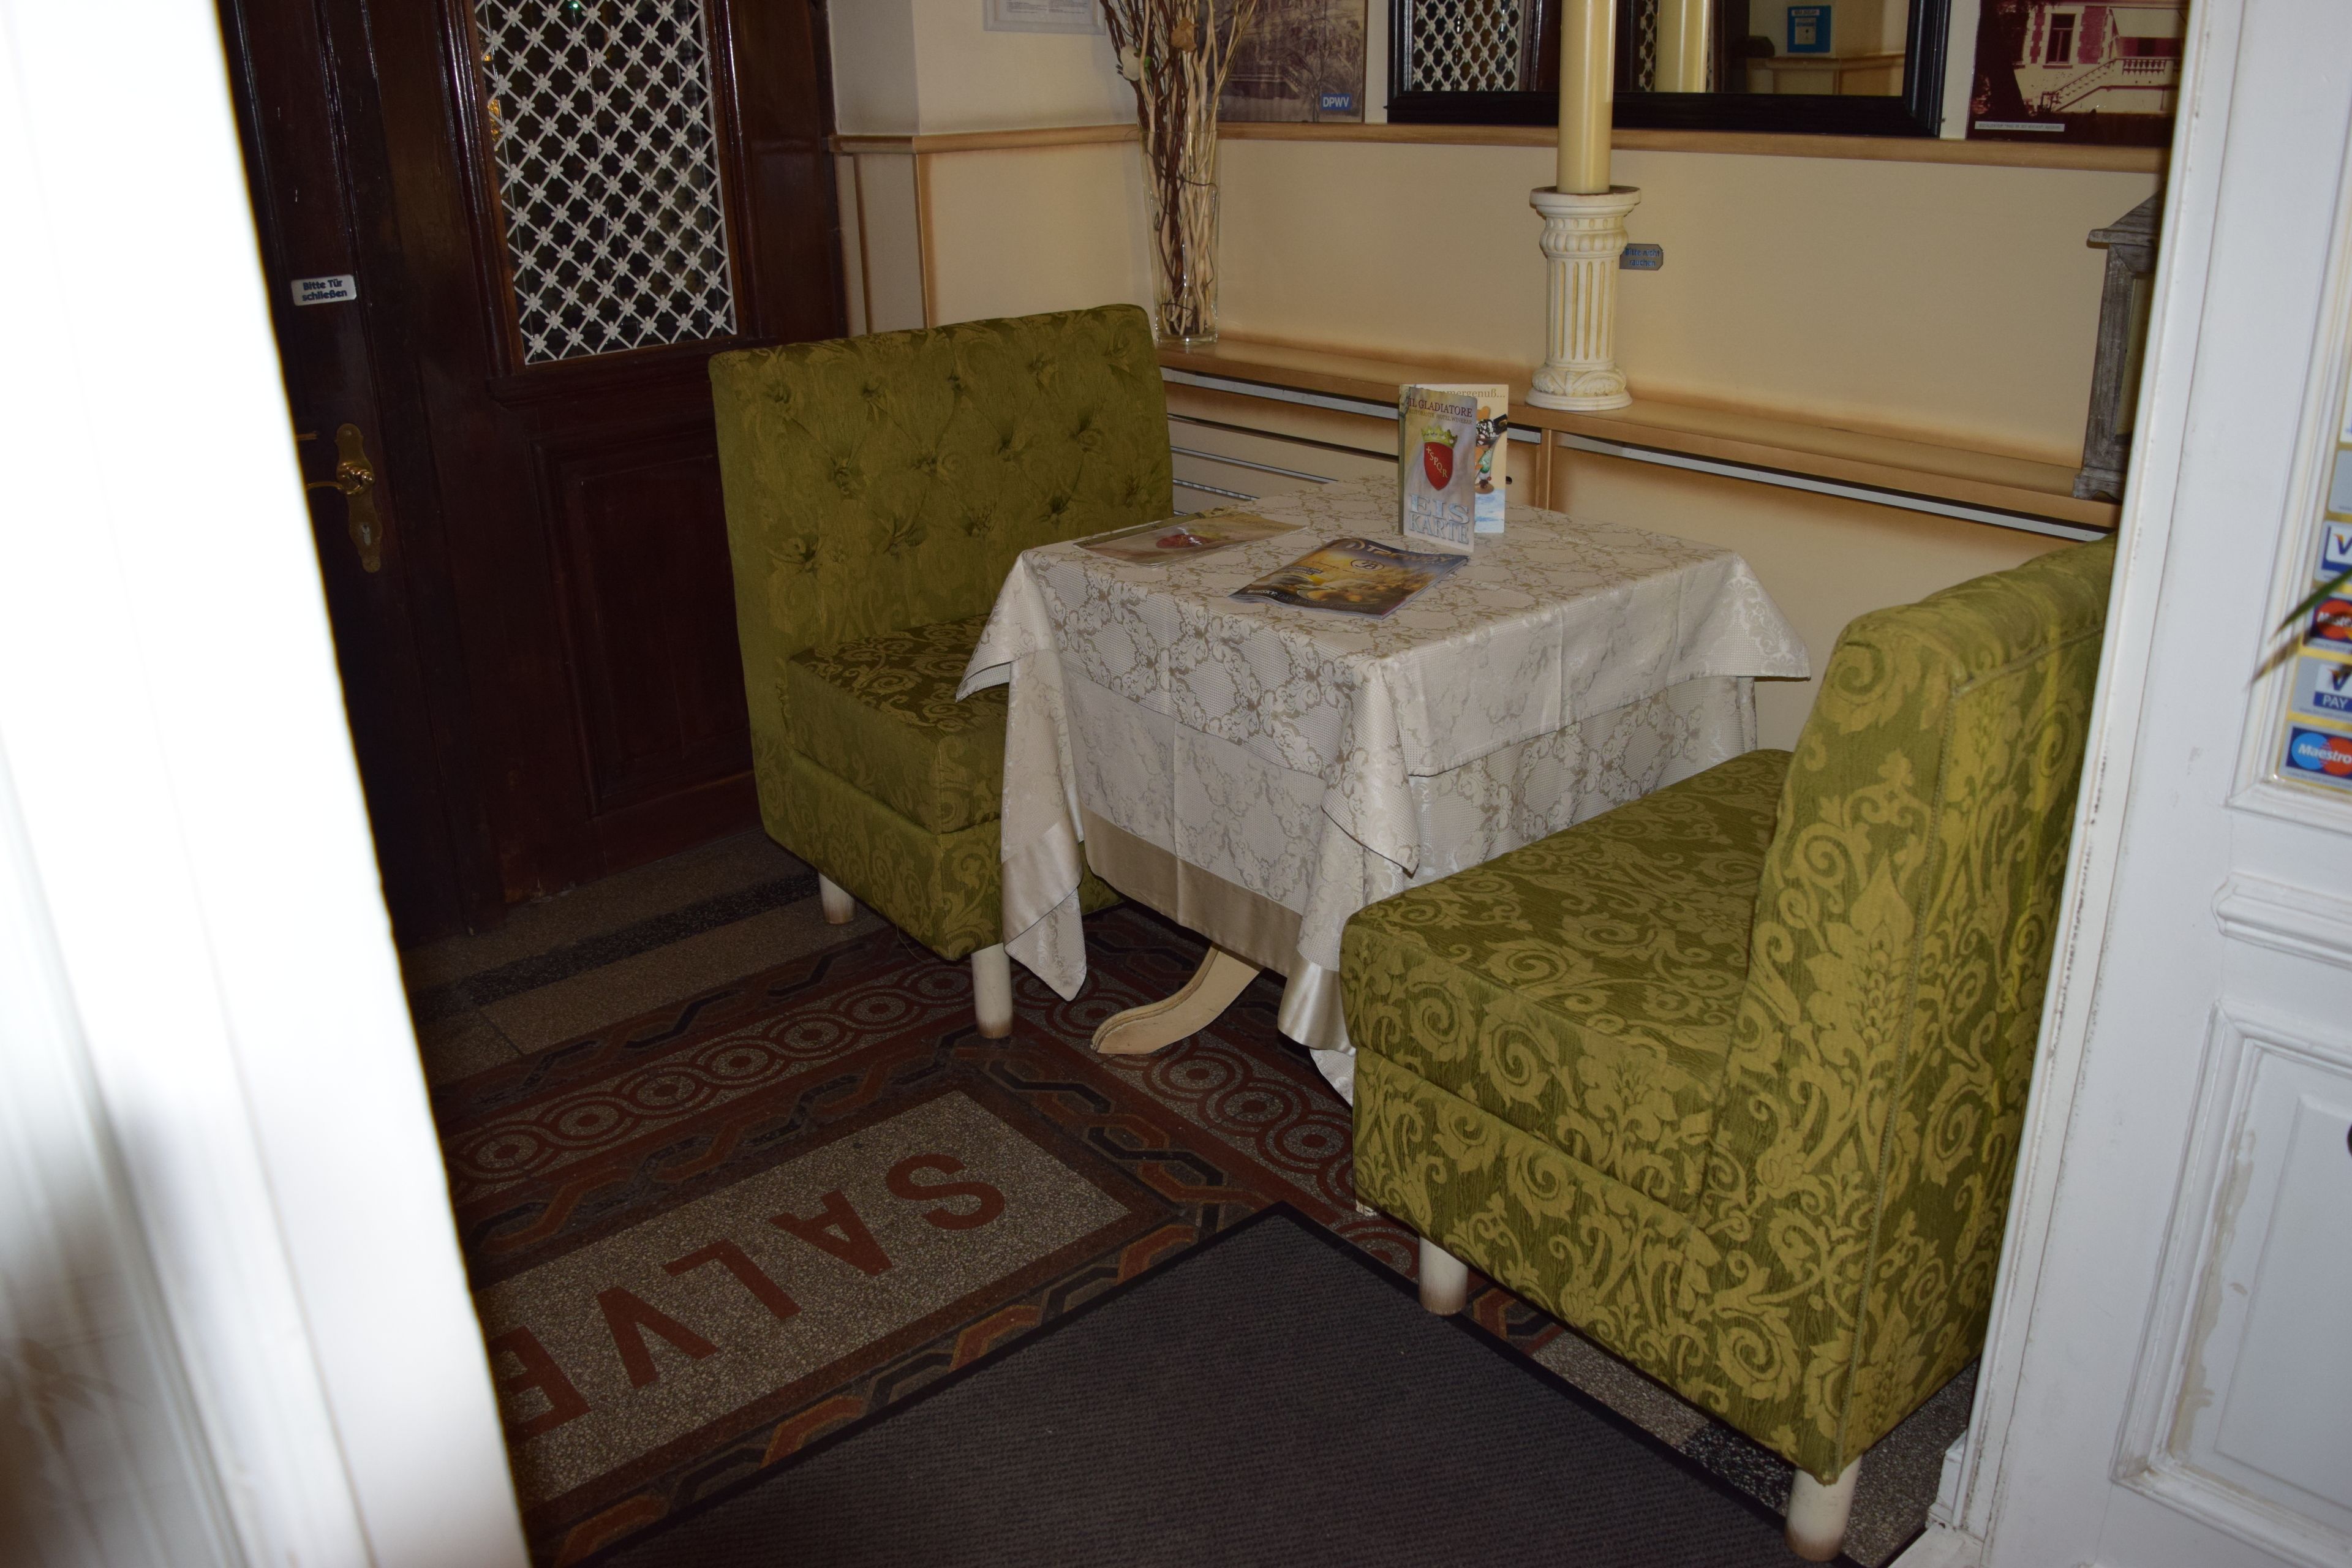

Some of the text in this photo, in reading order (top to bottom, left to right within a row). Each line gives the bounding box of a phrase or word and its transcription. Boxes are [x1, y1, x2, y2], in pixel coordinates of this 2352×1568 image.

[1322, 97, 1350, 108] DPWV
[303, 279, 343, 290] Bitte Tür
[302, 290, 348, 301] schließen
[1409, 398, 1472, 418] IL GLADIATORE
[1410, 494, 1470, 525] EIS
[1409, 514, 1469, 545] KARTE
[2323, 695, 2348, 709] PAY
[2297, 744, 2352, 764] Maestro
